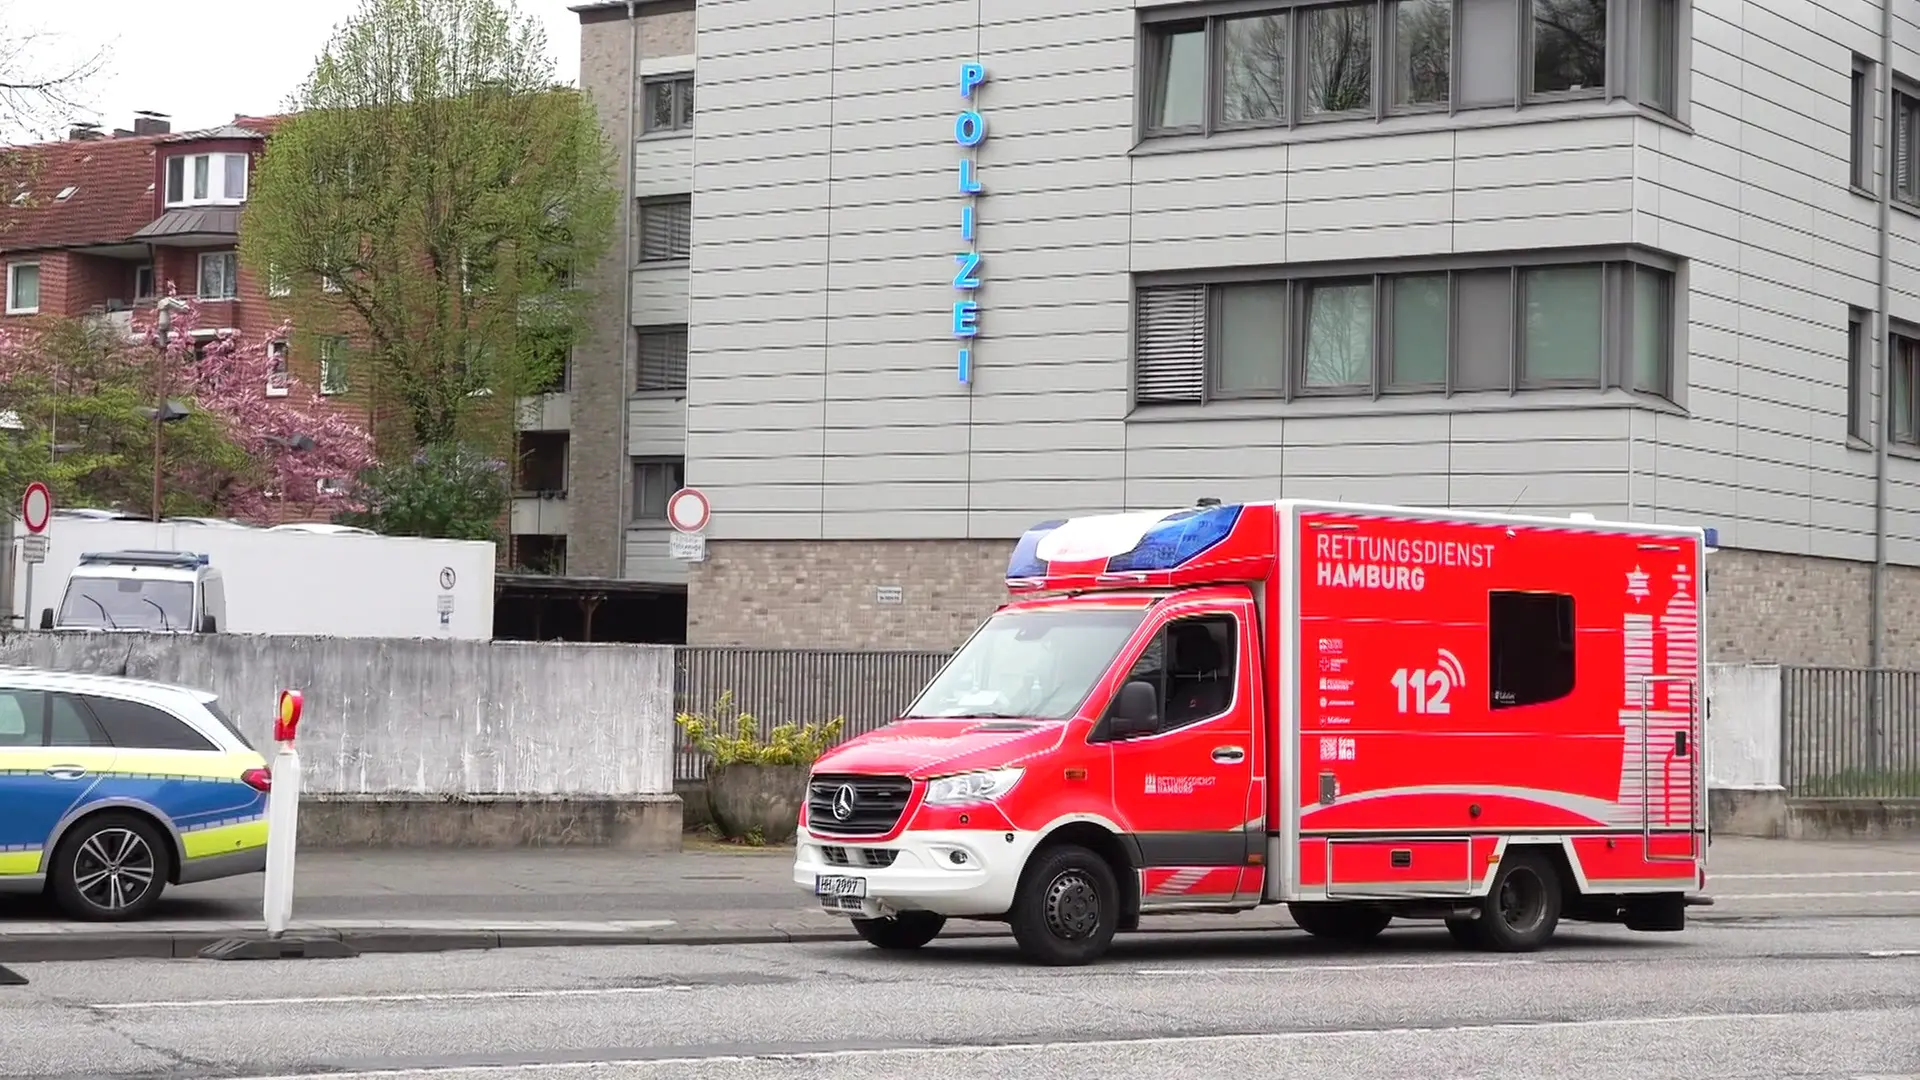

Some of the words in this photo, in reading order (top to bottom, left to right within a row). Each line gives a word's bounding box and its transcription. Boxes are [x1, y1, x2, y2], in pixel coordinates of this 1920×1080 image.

[952, 63, 985, 384] POLIZEI
[1317, 534, 1494, 567] RETTUNGSDIENST
[1316, 562, 1425, 591] HAMBURG
[1390, 667, 1451, 715] 112
